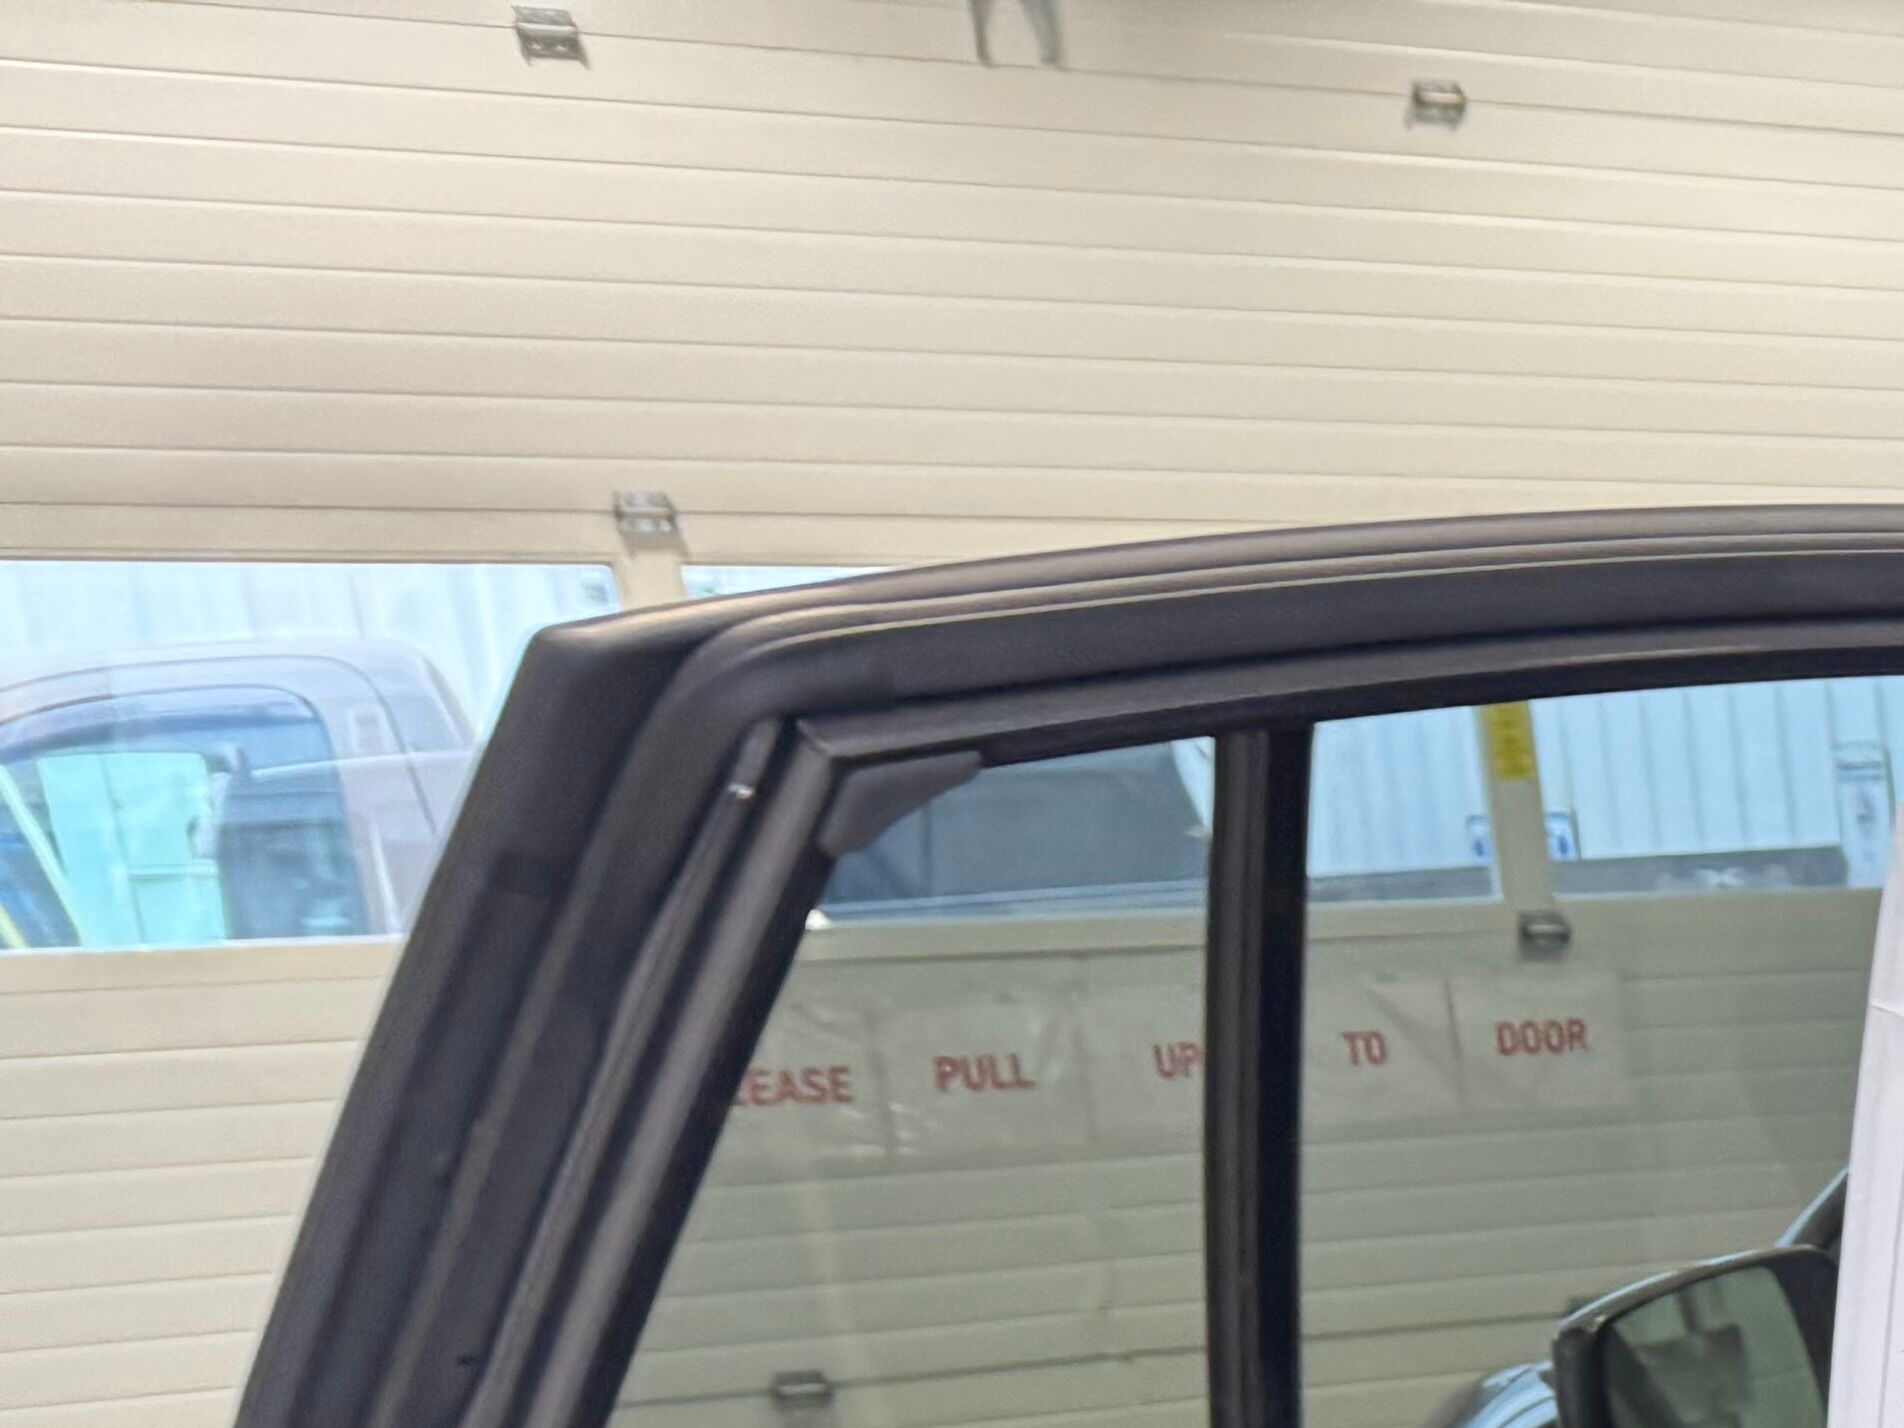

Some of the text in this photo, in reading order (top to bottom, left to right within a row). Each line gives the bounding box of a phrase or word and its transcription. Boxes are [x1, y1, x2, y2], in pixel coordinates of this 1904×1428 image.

[932, 1053, 1036, 1093] PULL
[1153, 1041, 1204, 1079] UP
[1342, 1030, 1388, 1066] TO
[1495, 1018, 1590, 1057] DOOR
